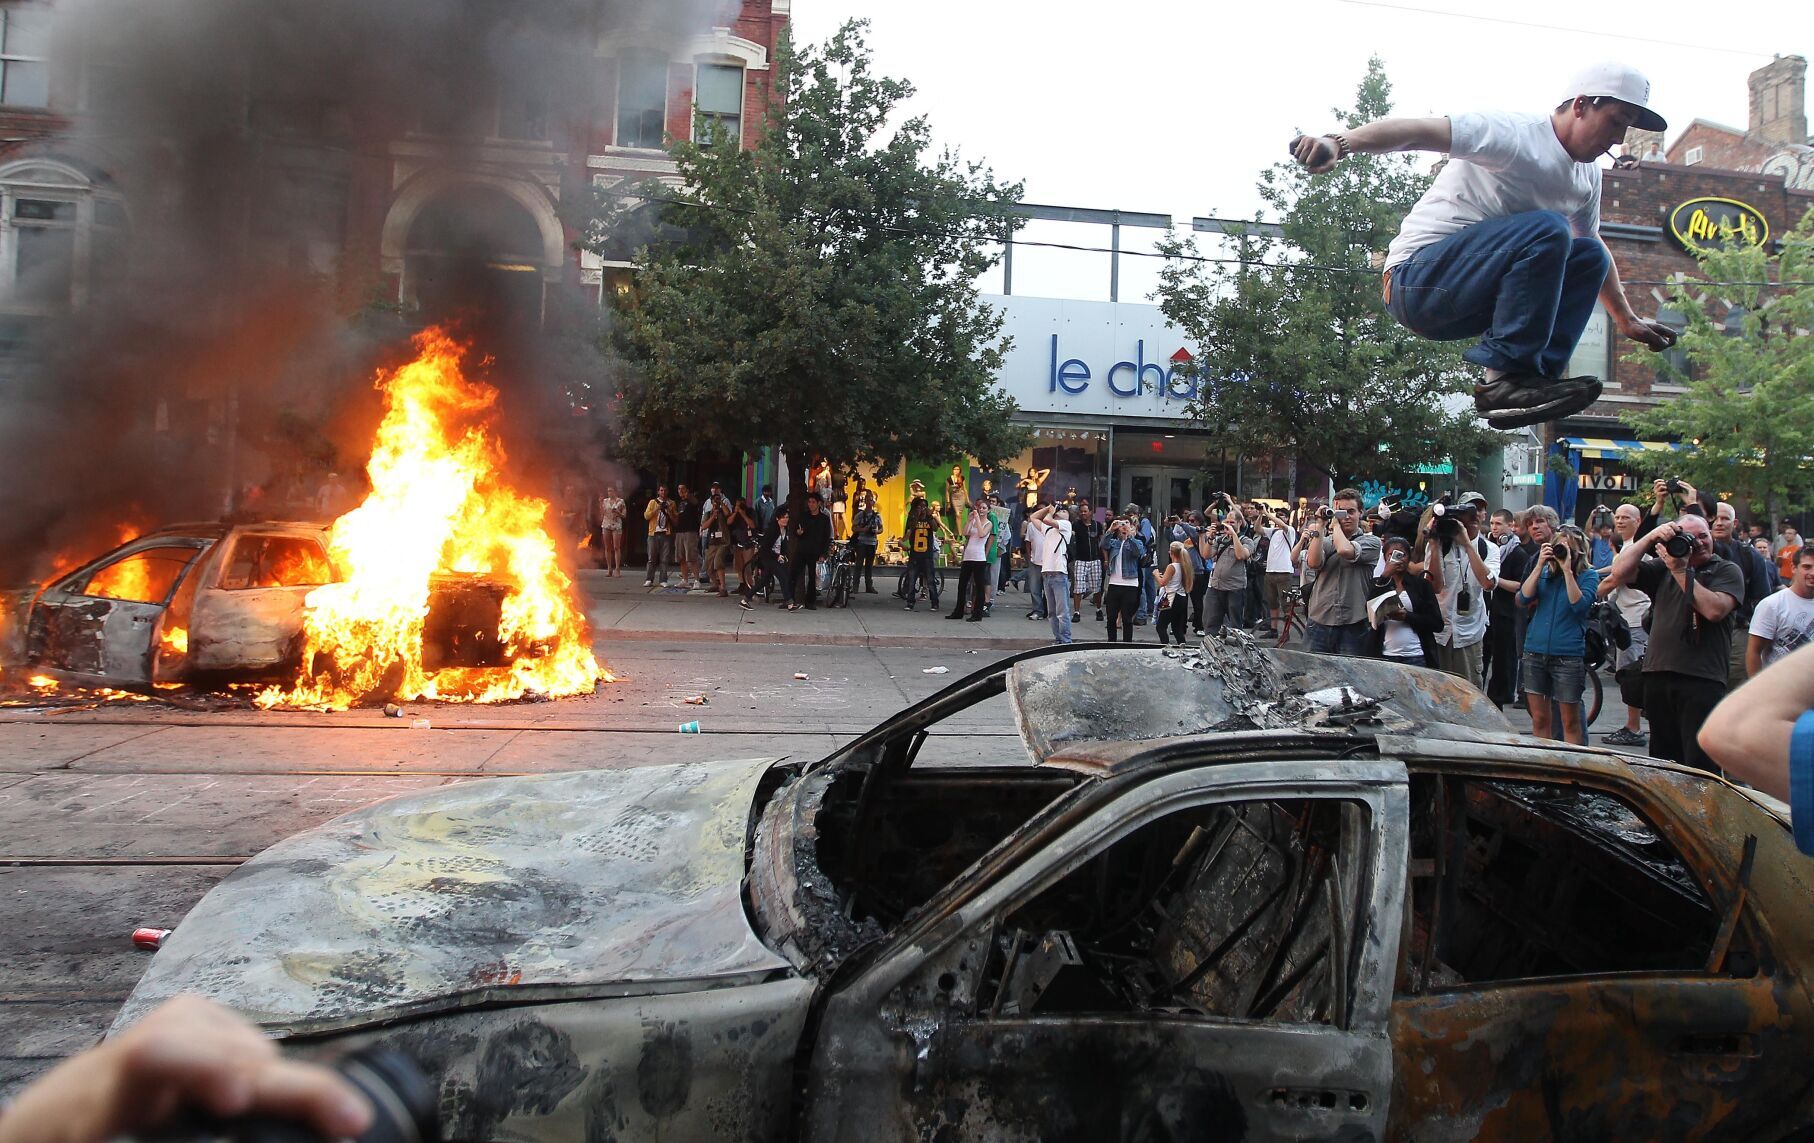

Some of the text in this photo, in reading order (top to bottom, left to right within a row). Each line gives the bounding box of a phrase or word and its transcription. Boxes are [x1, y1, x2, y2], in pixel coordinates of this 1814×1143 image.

[1048, 333, 1092, 394] le
[1582, 475, 1635, 490] IVOLI
[914, 528, 929, 553] 6
